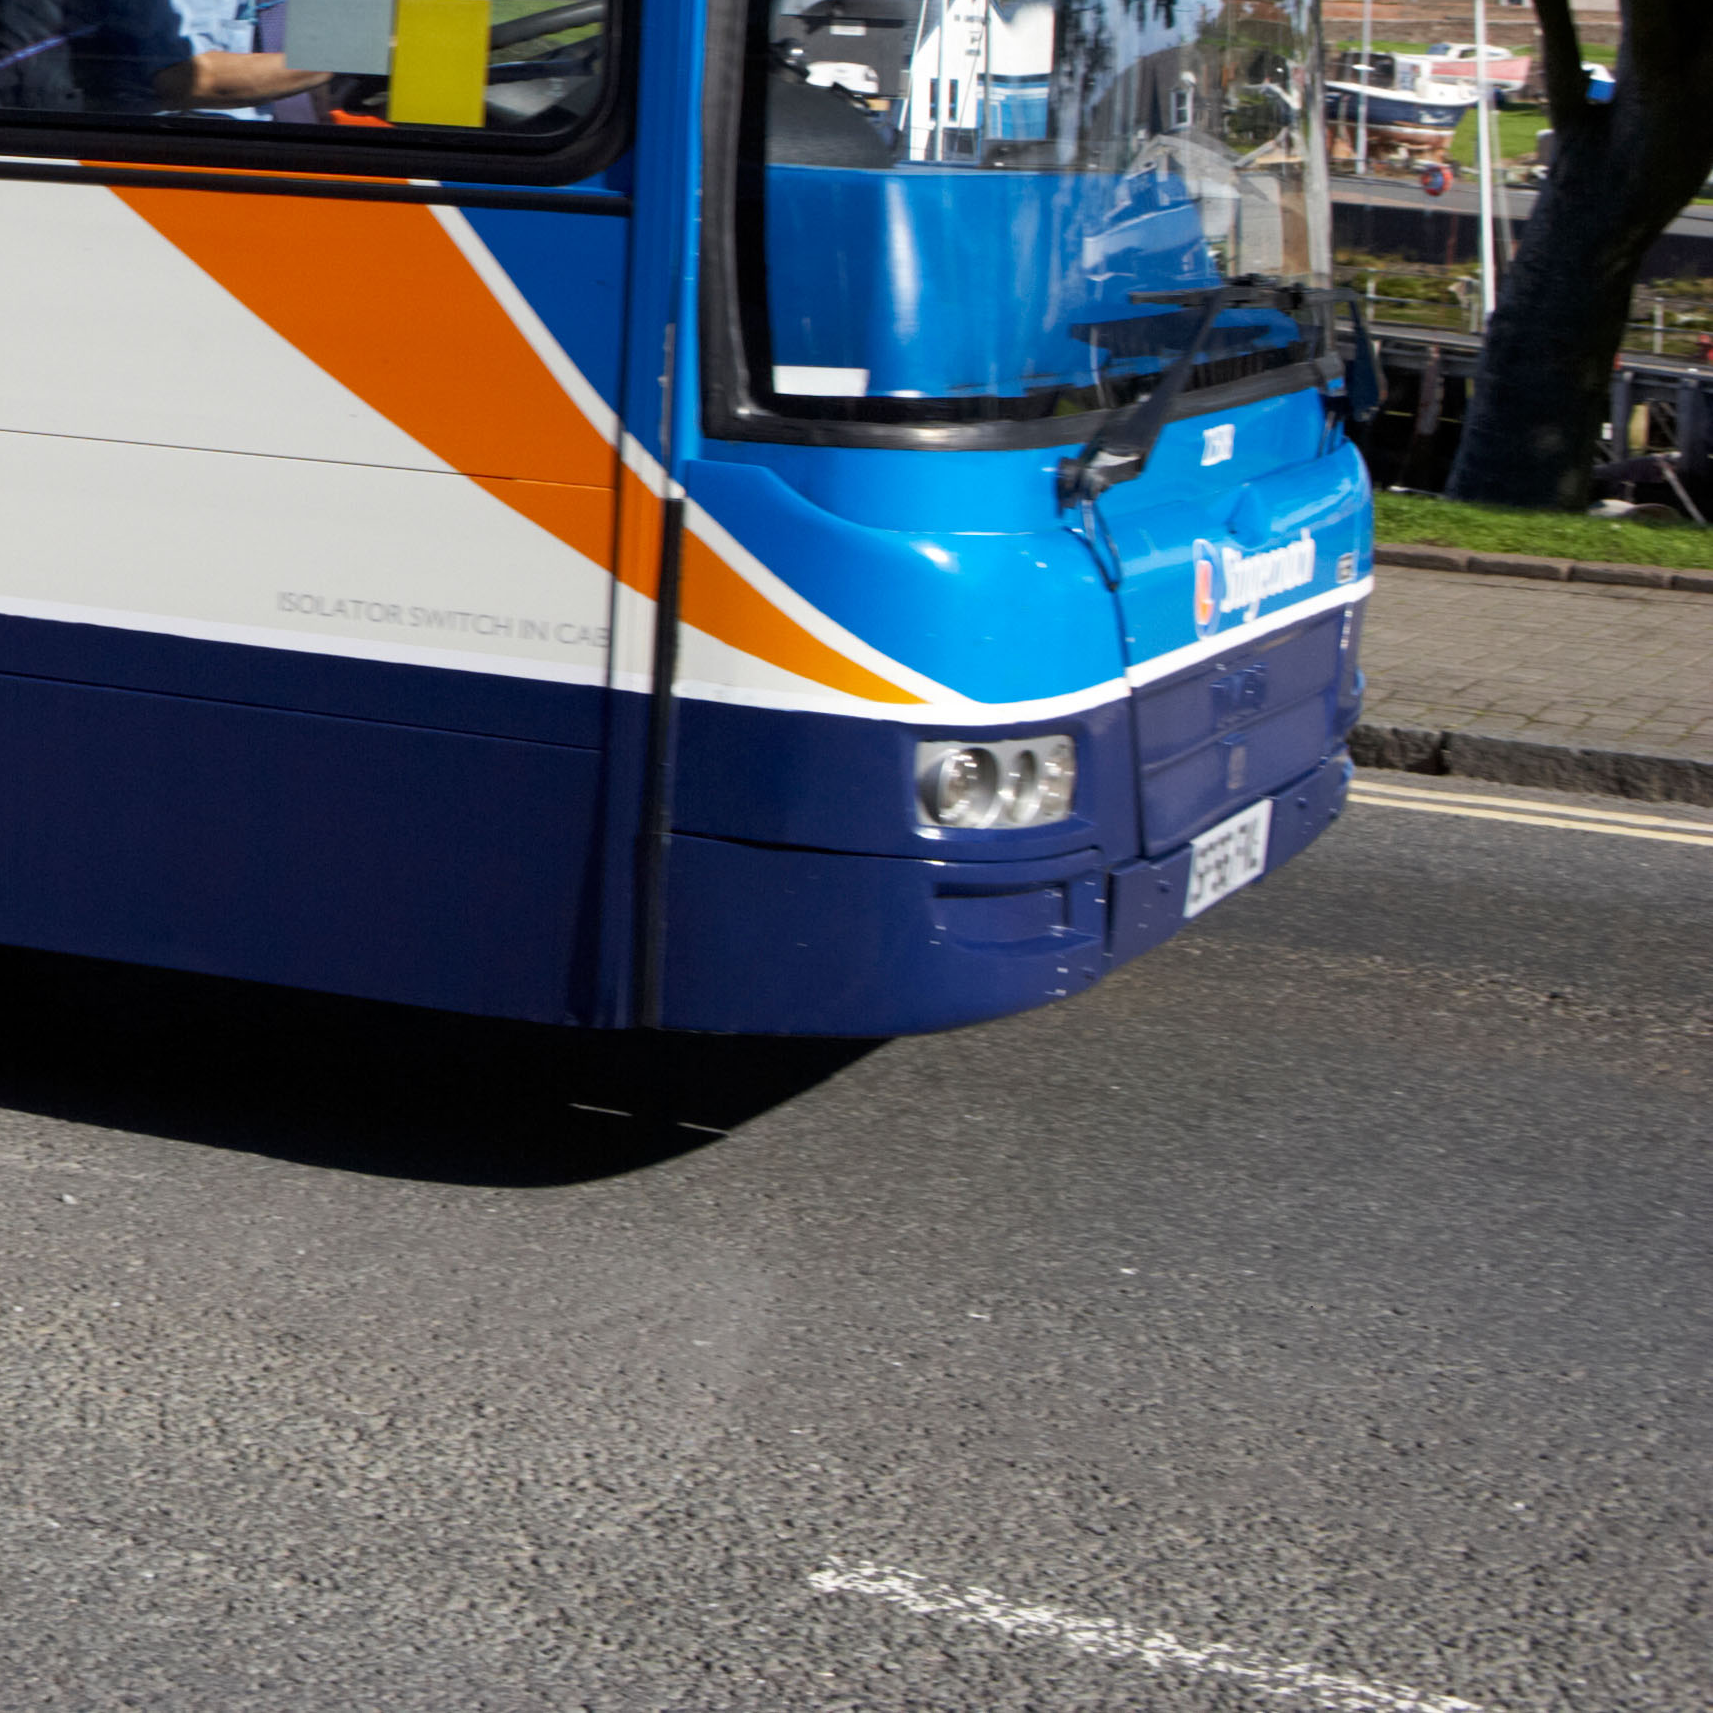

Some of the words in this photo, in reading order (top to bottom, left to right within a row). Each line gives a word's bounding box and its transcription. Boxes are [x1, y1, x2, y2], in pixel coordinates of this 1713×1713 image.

[276, 590, 403, 625] ISOLATOR
[409, 606, 510, 636] SWITCH
[518, 619, 550, 641] IN
[554, 623, 611, 648] CAB
